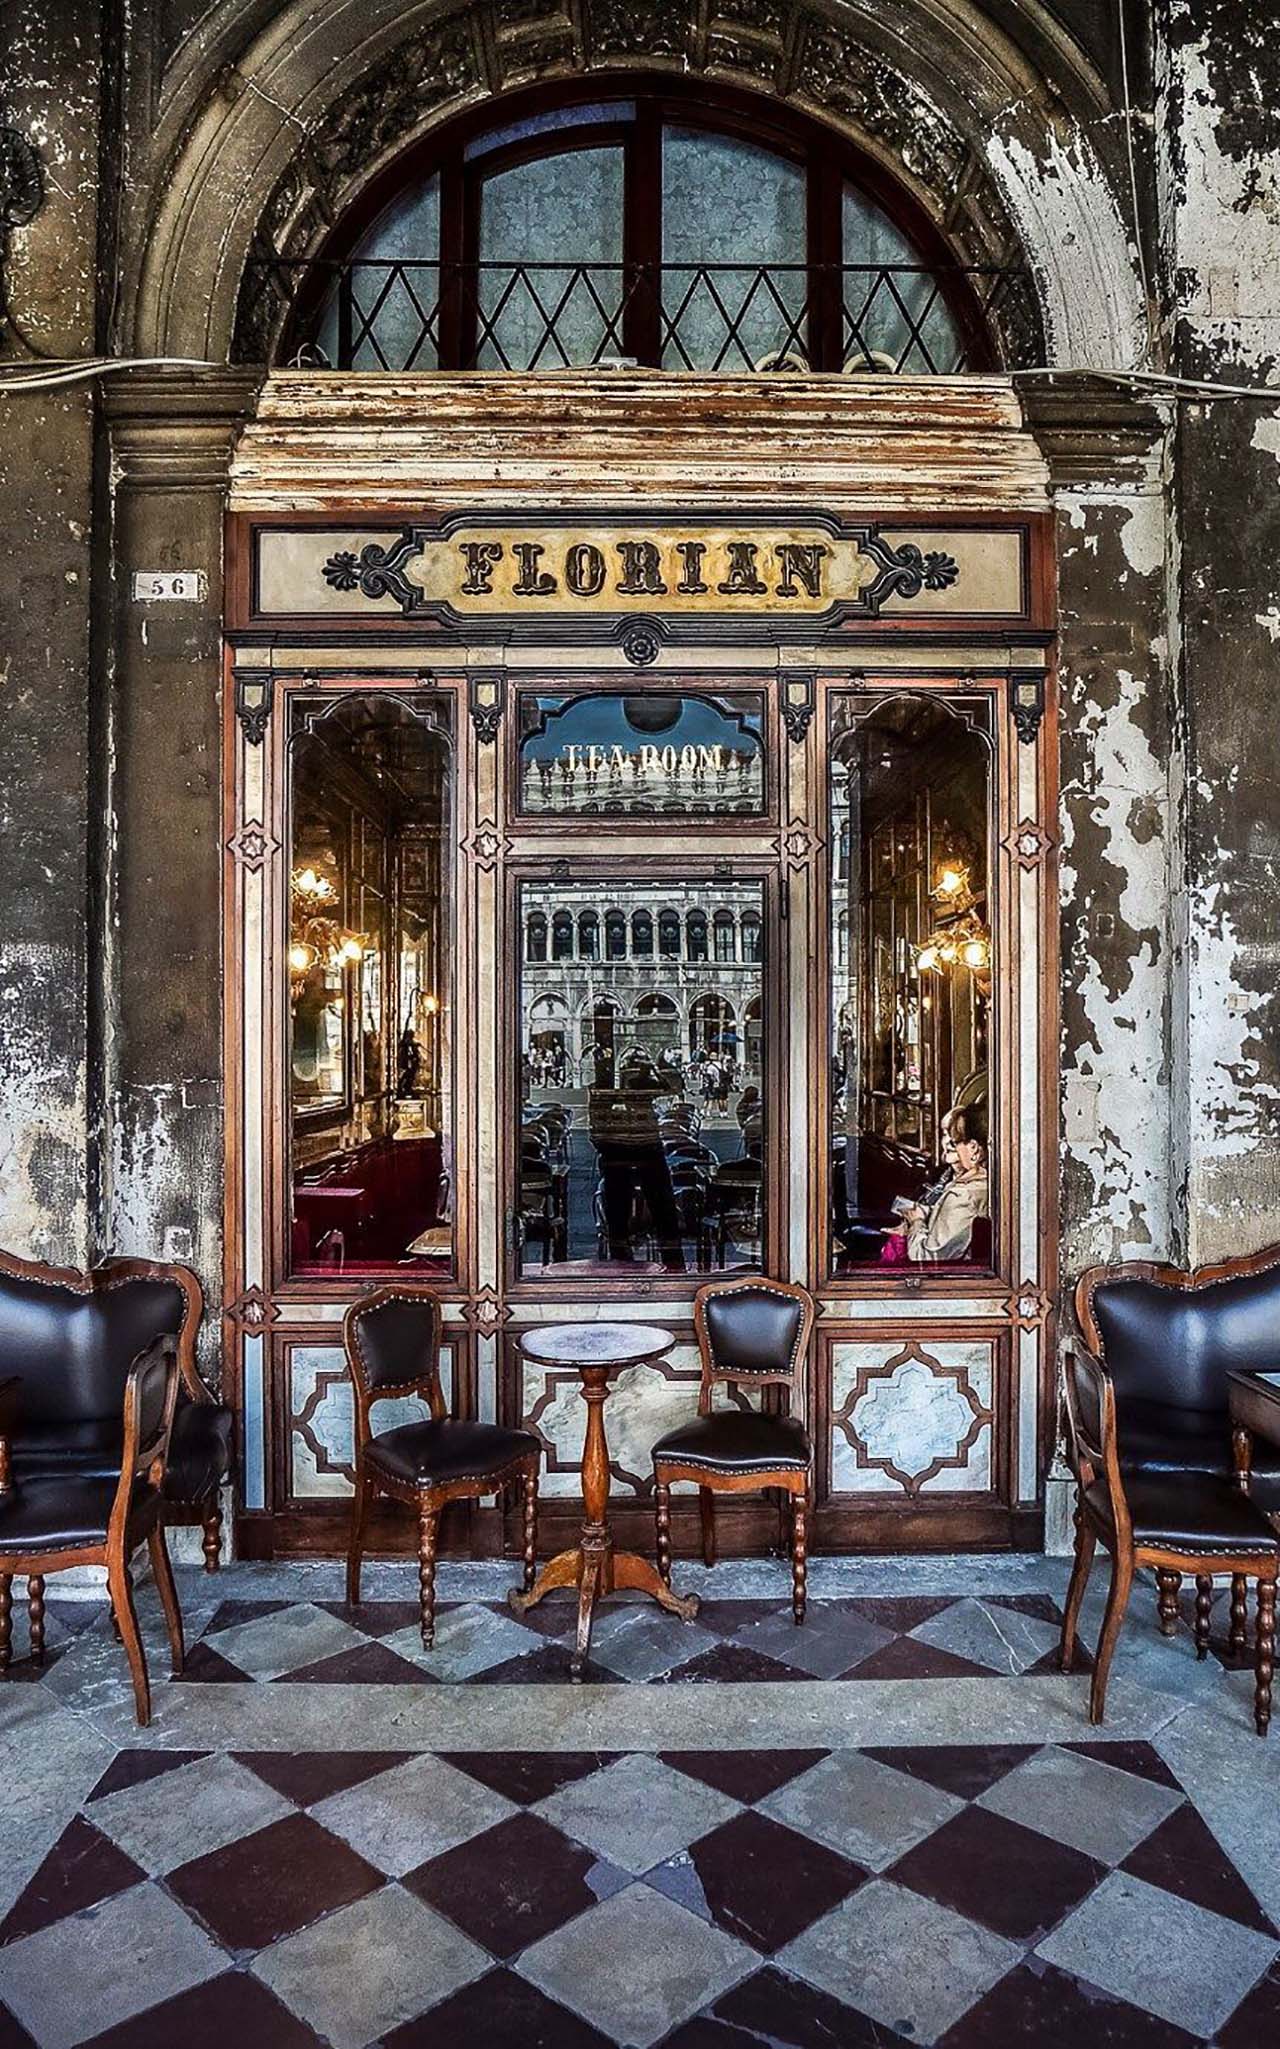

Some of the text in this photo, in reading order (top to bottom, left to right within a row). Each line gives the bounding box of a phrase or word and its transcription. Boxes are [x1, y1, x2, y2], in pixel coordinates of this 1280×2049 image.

[459, 540, 829, 597] FLORIAN
[562, 744, 724, 772] TEA ROOM
